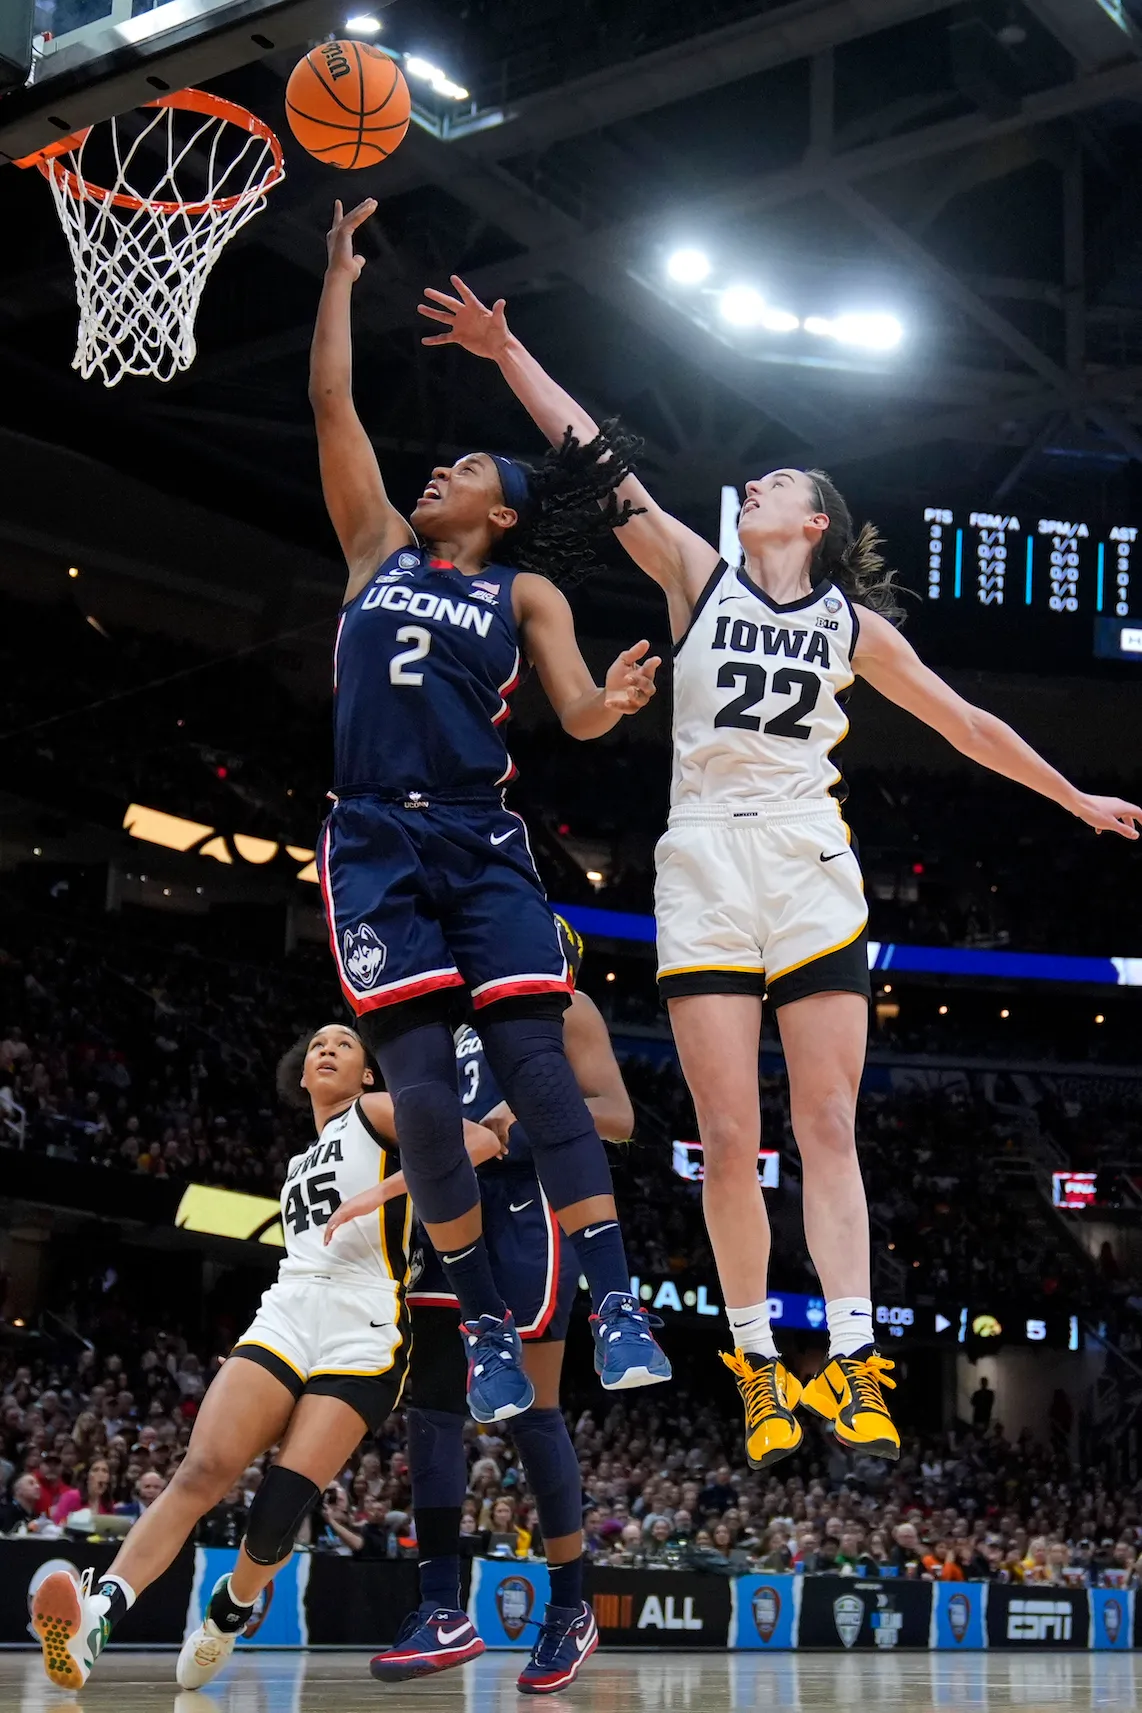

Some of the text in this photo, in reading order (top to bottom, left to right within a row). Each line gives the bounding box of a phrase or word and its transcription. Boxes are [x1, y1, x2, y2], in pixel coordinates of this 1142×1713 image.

[924, 508, 953, 524] PTS
[969, 512, 1020, 531] FGM/A
[1109, 526, 1138, 542] AST
[930, 524, 1130, 557] 3 1/1 1/1 0
[929, 539, 942, 553] 0
[977, 544, 1007, 560] 0/0
[1050, 551, 1079, 567] 0/0
[929, 554, 941, 568] 2
[1050, 565, 1079, 582] 0/0
[1116, 572, 1129, 586] 0
[978, 574, 1004, 590] 1/1
[1051, 580, 1077, 597] 1/1
[1118, 587, 1127, 601] 1
[978, 589, 1004, 605] 1/1
[1049, 595, 1078, 612] 0/0
[1116, 602, 1129, 616] 0
[361, 585, 493, 638] UCONN
[389, 625, 432, 686] 2
[711, 616, 830, 669] IOWA
[714, 661, 821, 740] 22
[404, 801, 429, 809] UCONN
[462, 1060, 480, 1105] 3
[285, 1171, 342, 1236] 45
[1025, 1319, 1047, 1340] 5
[637, 1595, 703, 1630] ALL
[1007, 1600, 1072, 1640] ESPN
